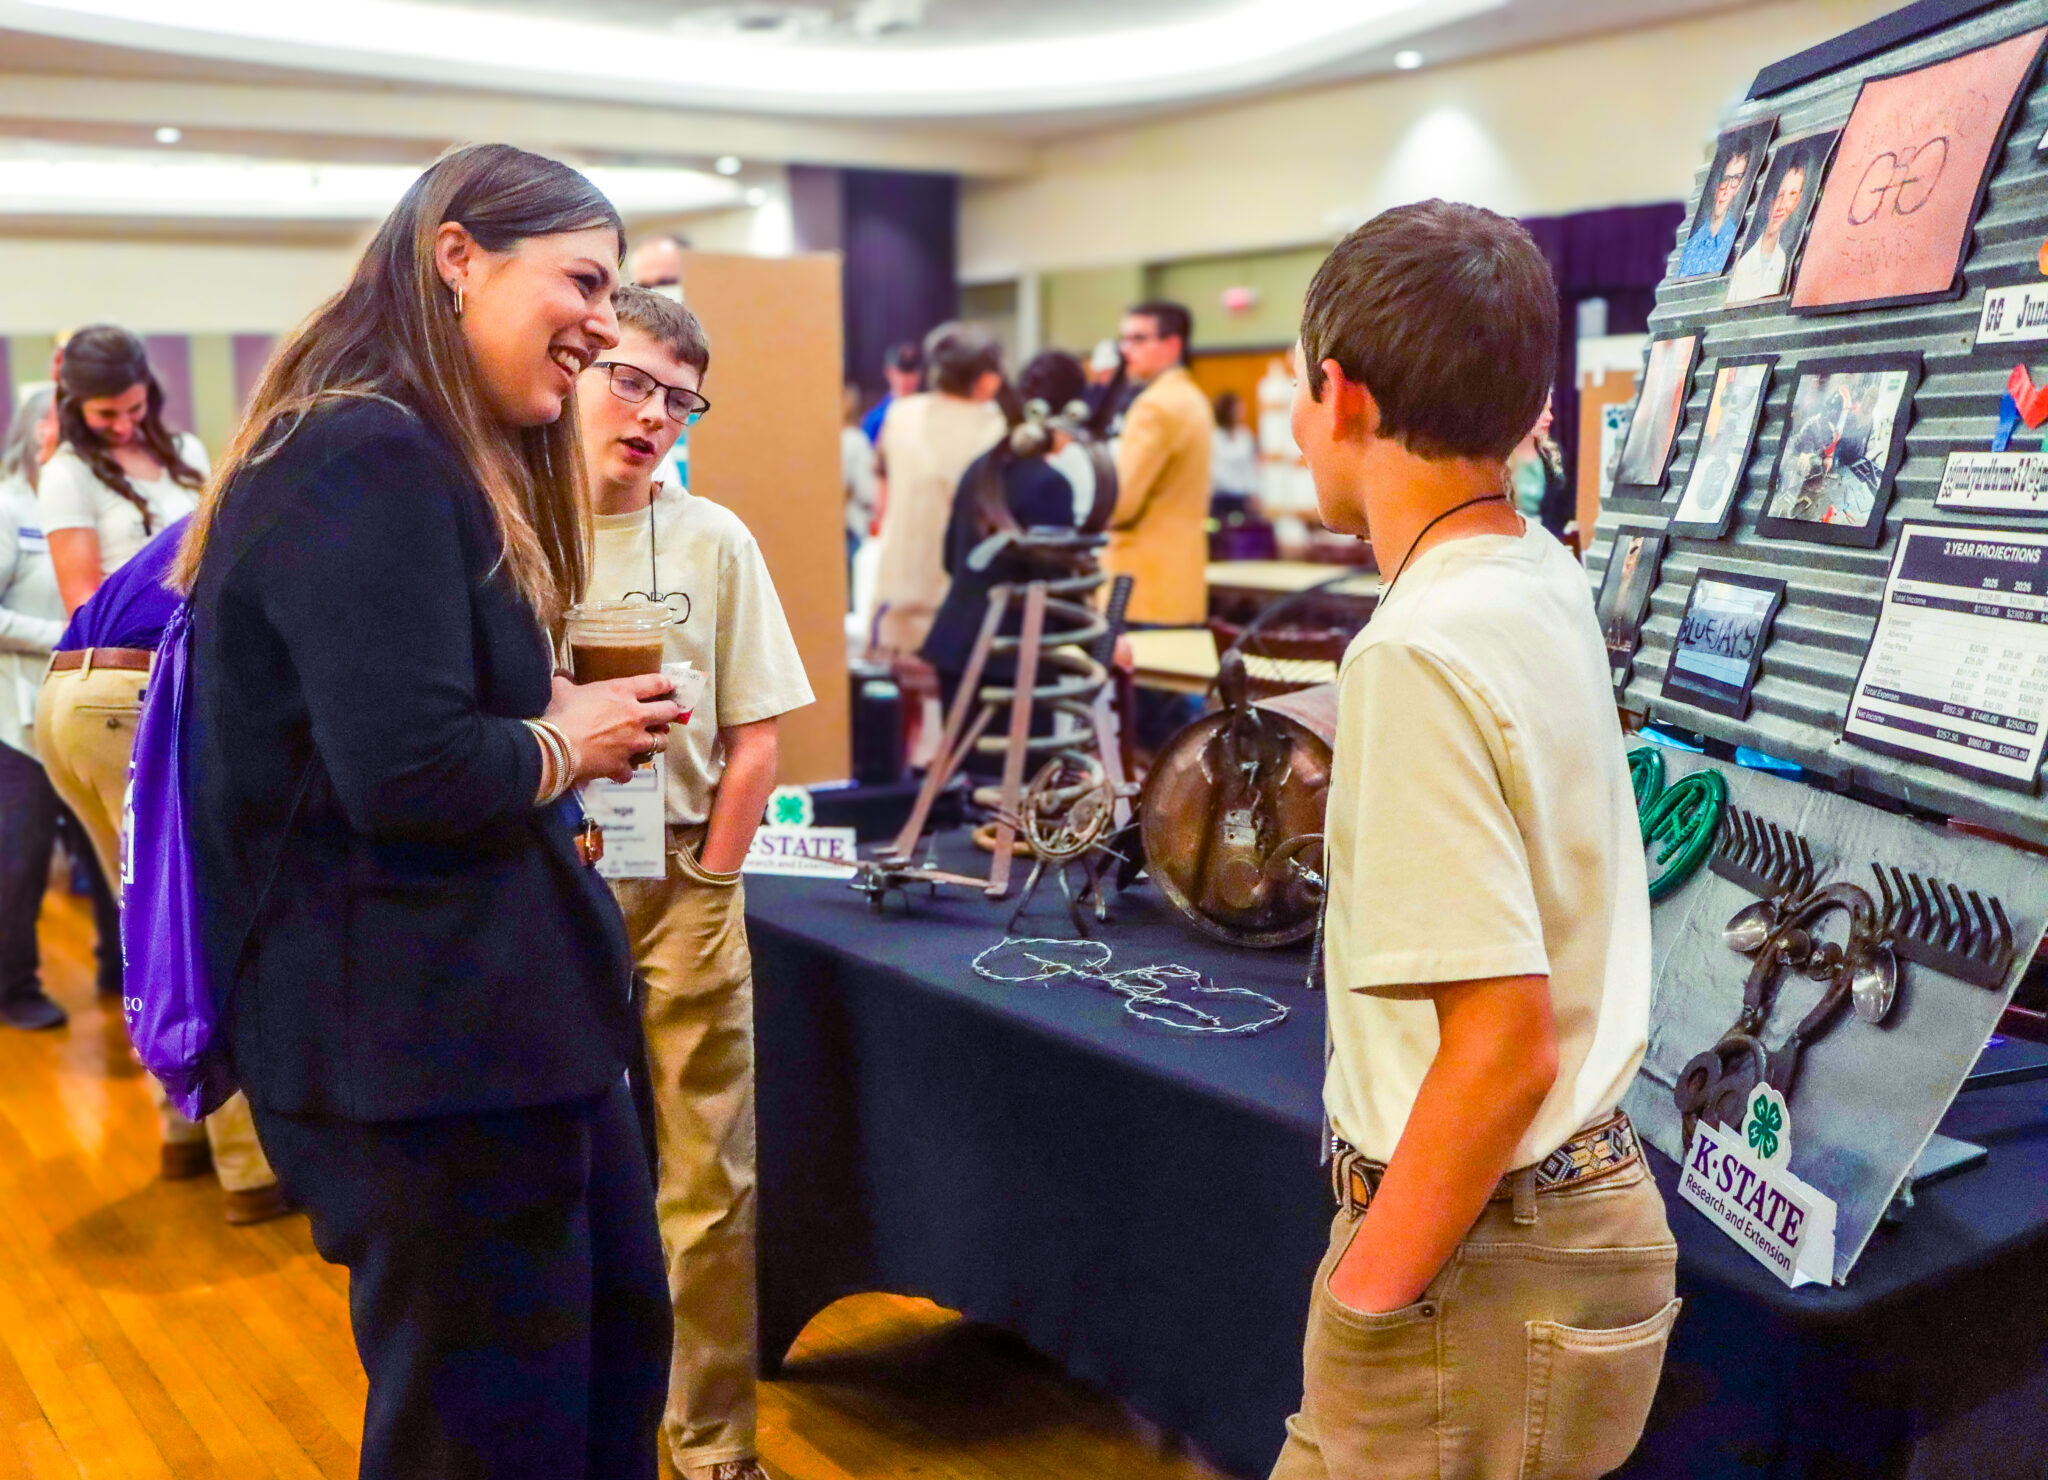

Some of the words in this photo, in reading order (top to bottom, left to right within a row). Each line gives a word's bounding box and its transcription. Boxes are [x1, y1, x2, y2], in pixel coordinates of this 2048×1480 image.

[1943, 541, 1950, 555] 3
[1951, 542, 1975, 557] YEAR
[1975, 544, 2042, 563] PROJECTIONS
[1685, 1173, 1725, 1218] Research
[1725, 1209, 1745, 1231] and
[1743, 1222, 1791, 1271] Extension
